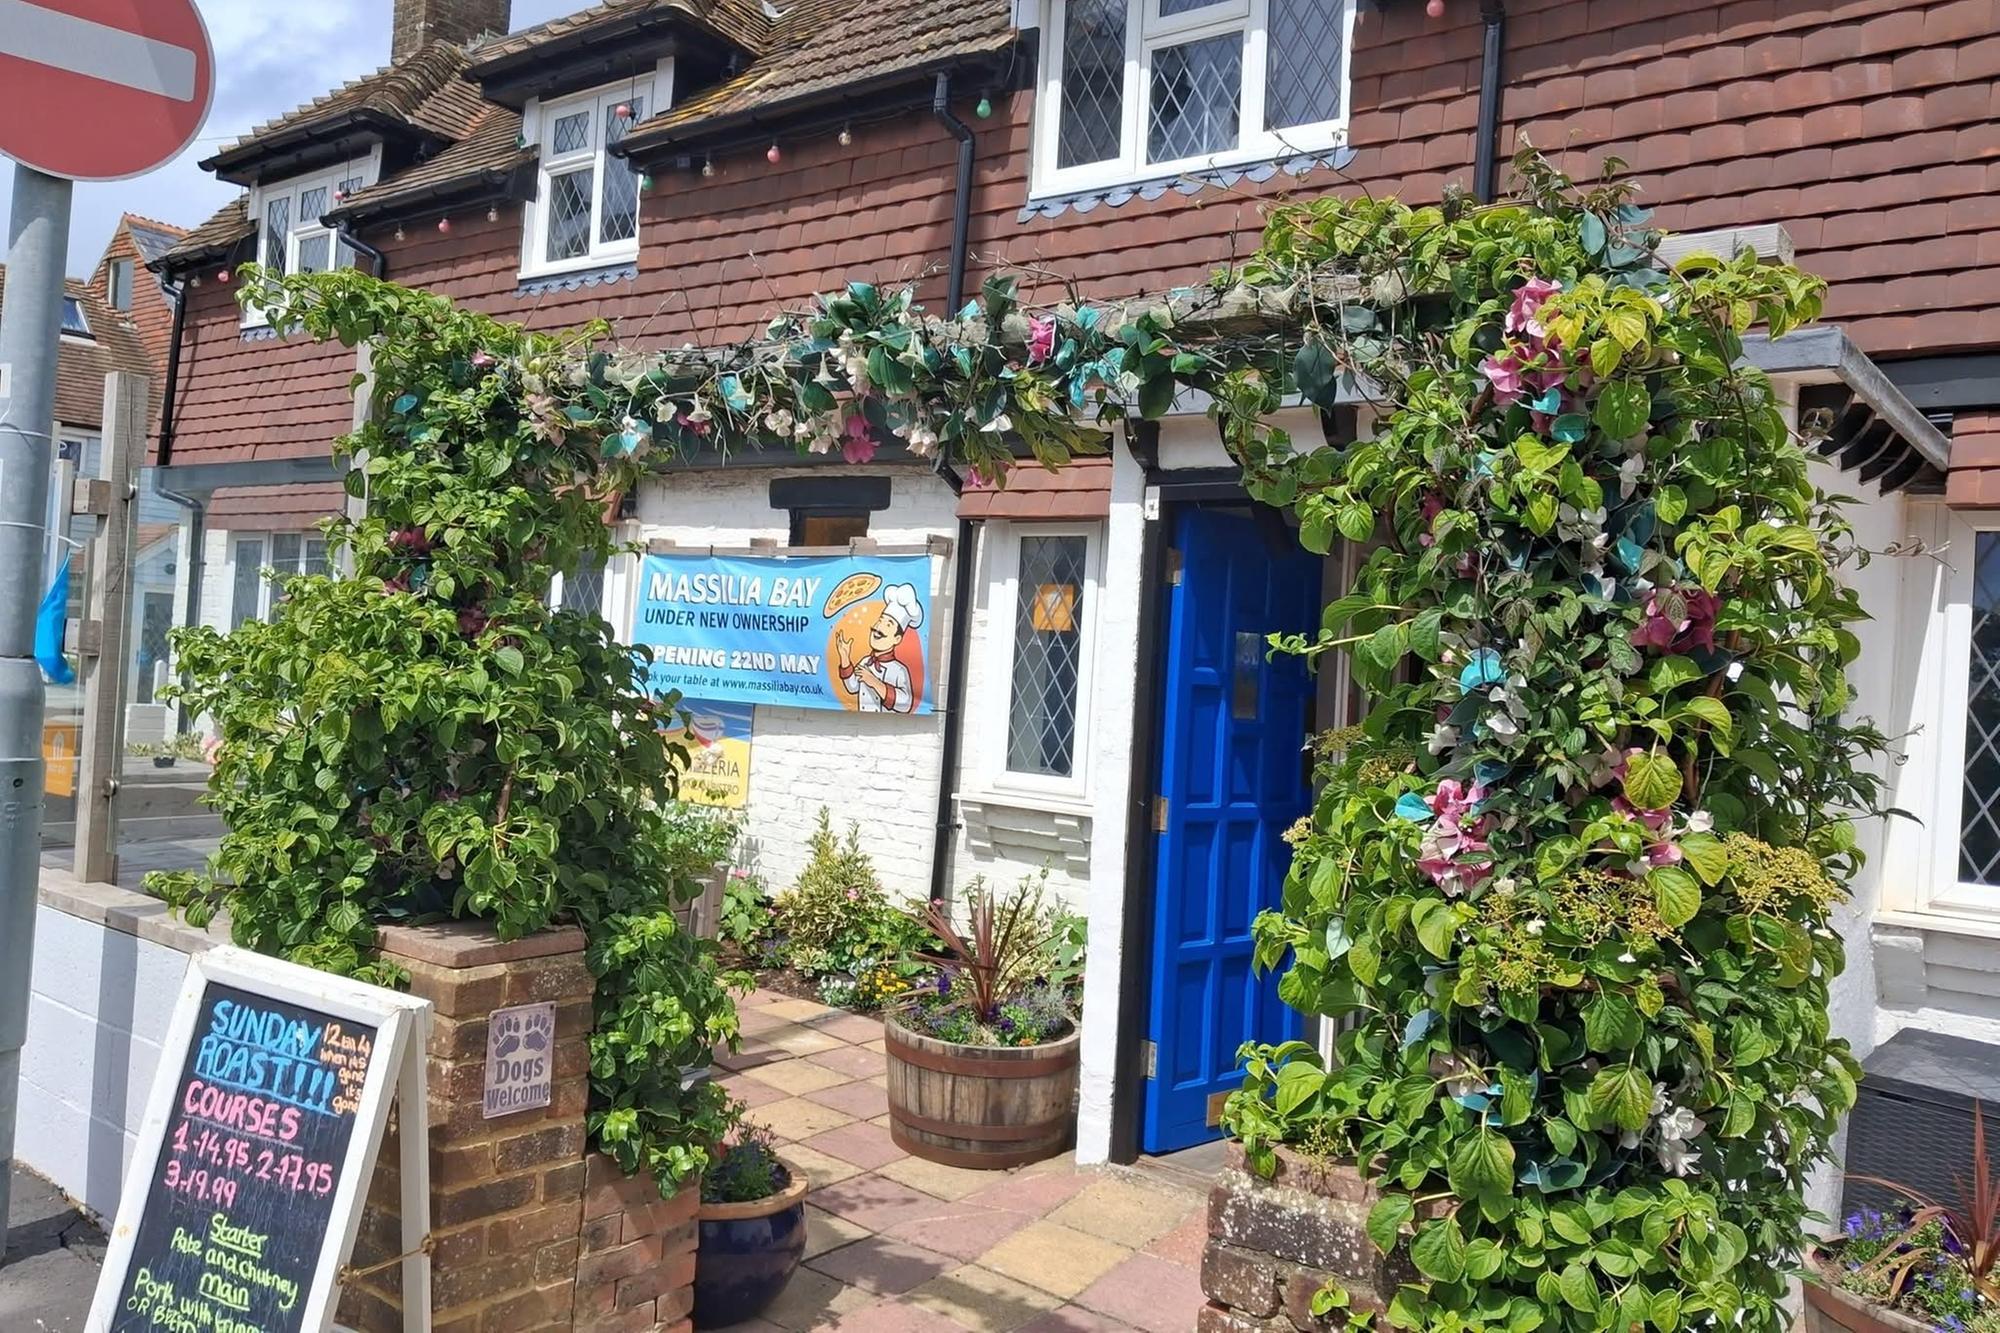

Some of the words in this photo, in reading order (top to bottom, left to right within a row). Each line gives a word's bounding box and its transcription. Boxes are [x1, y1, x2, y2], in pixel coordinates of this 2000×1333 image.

[648, 571, 761, 606] MASSILIA
[768, 575, 822, 608] BAY
[645, 607, 696, 627] UNDER
[700, 611, 730, 629] NEW
[732, 612, 810, 633] OWNERSHIP
[729, 648, 777, 674] 22ND
[780, 652, 822, 677] MAY
[660, 672, 681, 686] your
[683, 673, 708, 688] table
[710, 676, 720, 688] at
[722, 678, 825, 697] www.massiliabay.co.uk
[210, 1000, 322, 1057] SUNDAY
[323, 1022, 341, 1048] 12
[357, 1033, 372, 1058] 4
[494, 1056, 545, 1085] Dogs
[184, 1080, 302, 1141] COURSES
[486, 1081, 550, 1111] Welcome
[170, 1226, 203, 1258] Pate
[210, 1213, 269, 1252] Starter
[134, 1267, 174, 1305] Pork
[126, 1295, 151, 1316] OR
